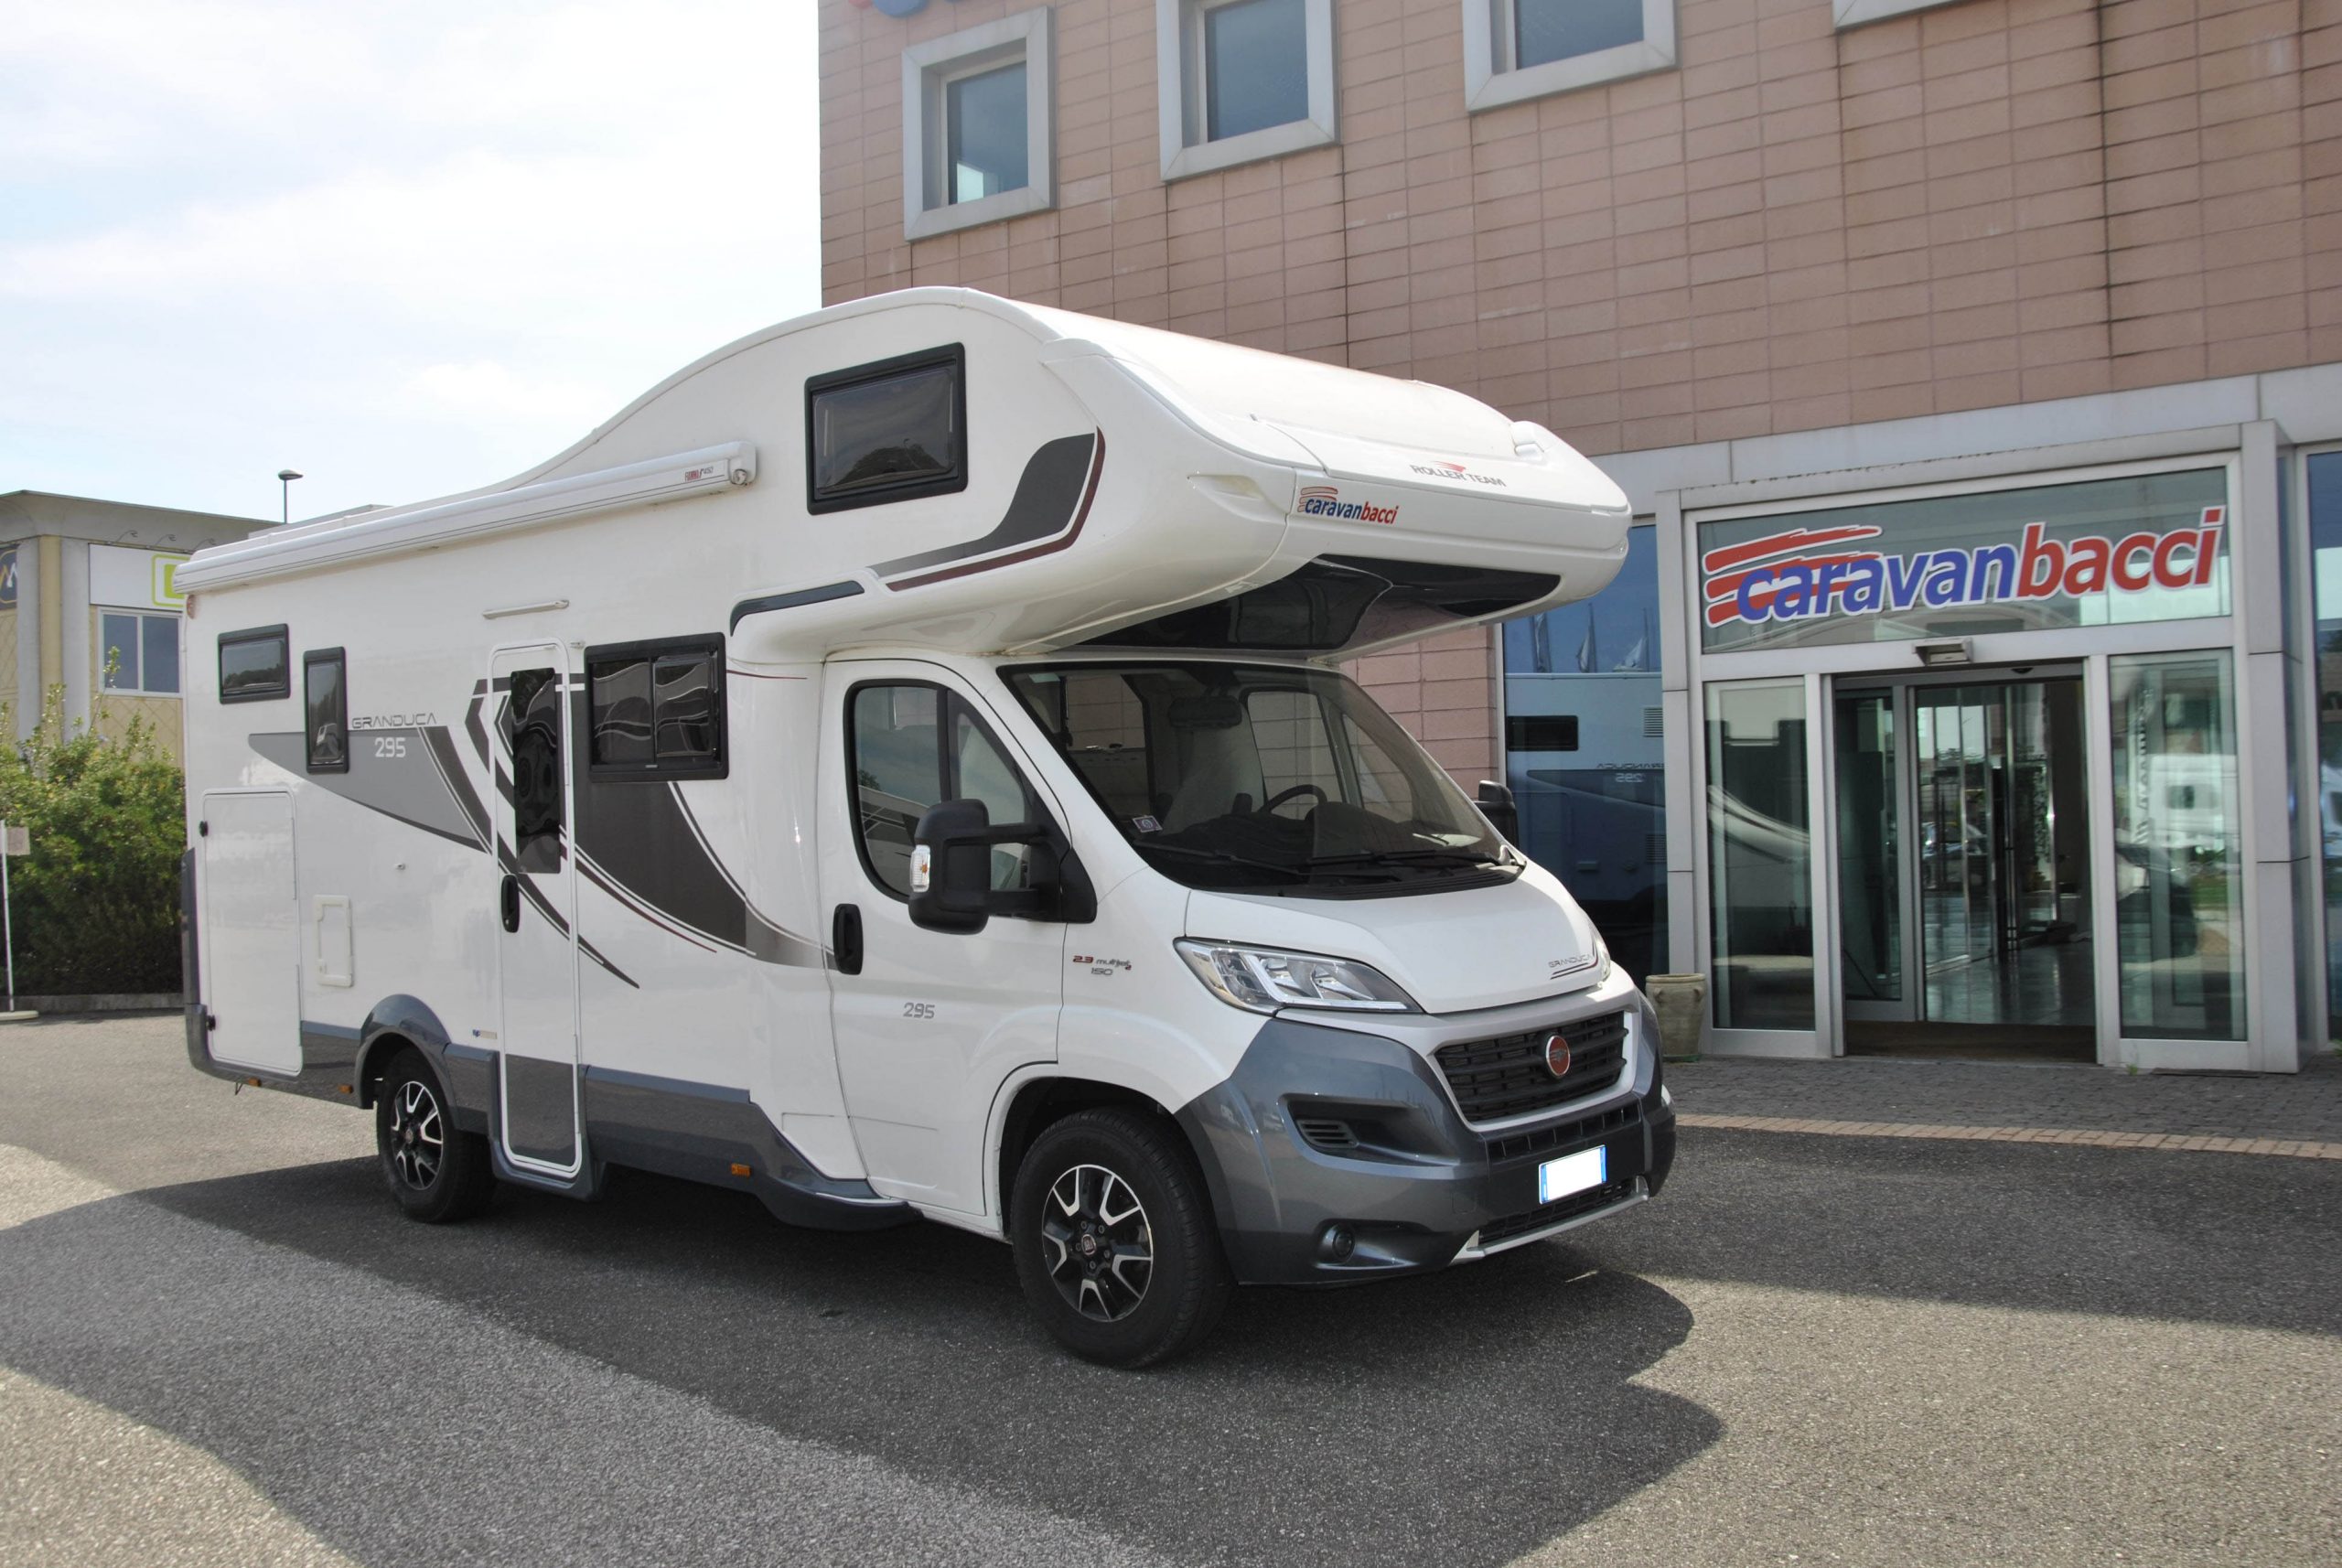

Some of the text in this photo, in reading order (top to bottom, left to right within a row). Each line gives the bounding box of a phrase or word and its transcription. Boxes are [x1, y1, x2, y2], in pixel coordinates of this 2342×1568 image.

[1410, 465, 1507, 488] ROLLER TEAM
[1305, 498, 1399, 524] caravanbacci
[1736, 506, 2224, 622] caravanbacci
[351, 713, 437, 729] GRANDUCA
[374, 736, 406, 758] 295
[1091, 967, 1113, 976] 150
[903, 1002, 935, 1019] 295
